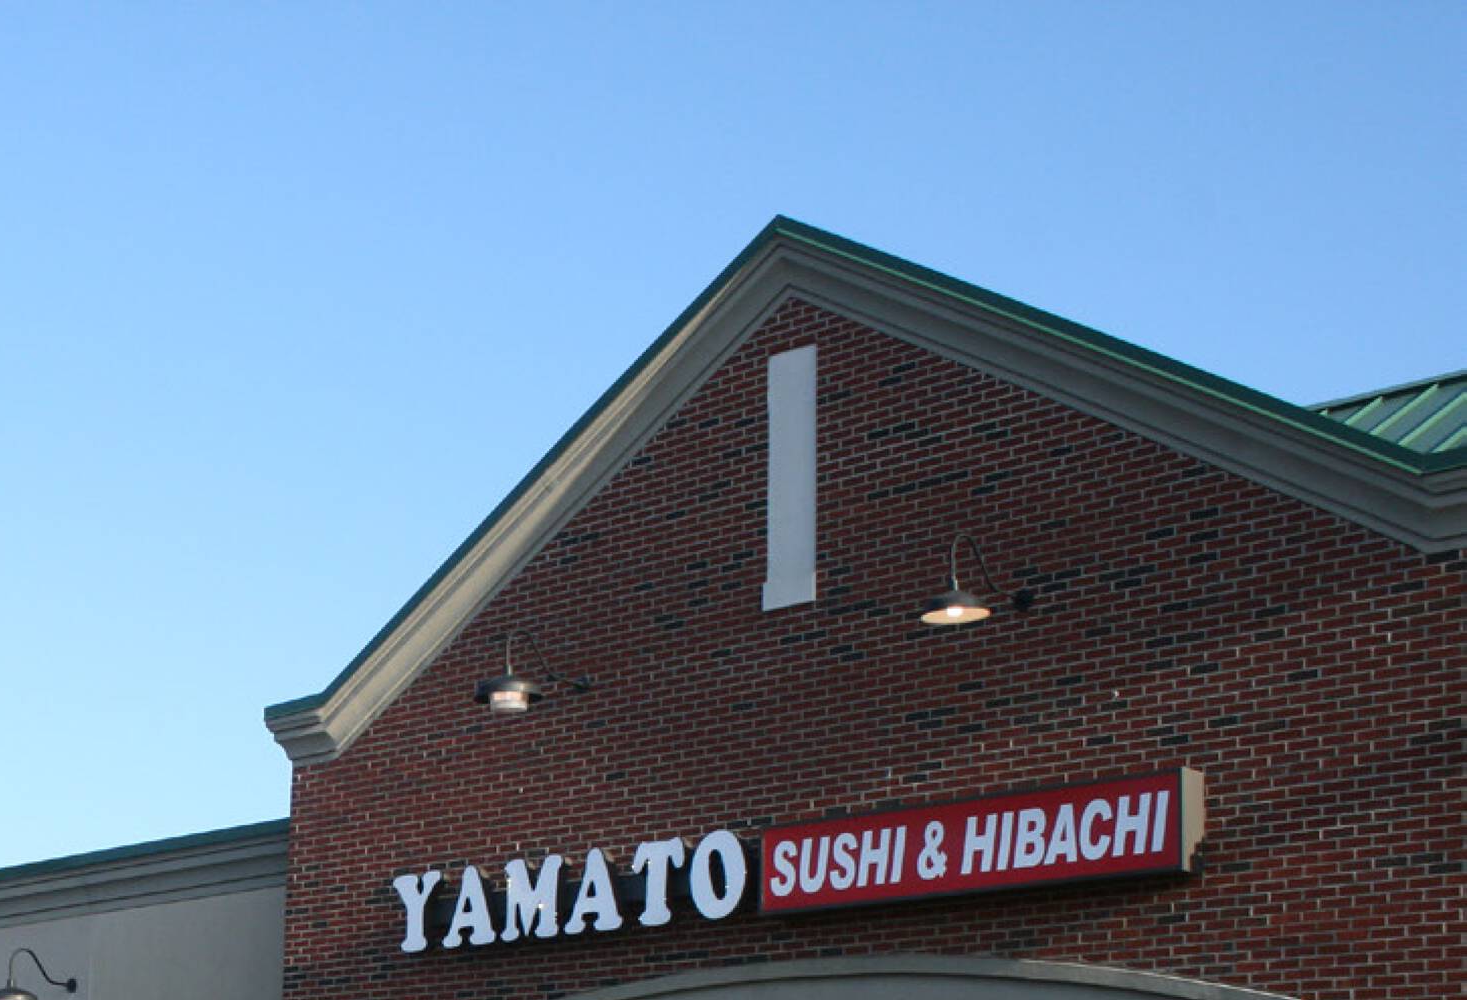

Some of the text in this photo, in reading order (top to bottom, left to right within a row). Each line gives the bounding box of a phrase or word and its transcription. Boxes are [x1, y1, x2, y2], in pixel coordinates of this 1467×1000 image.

[393, 829, 746, 953] YAMATO
[770, 790, 1170, 897] SUSHI & HIBACHI
